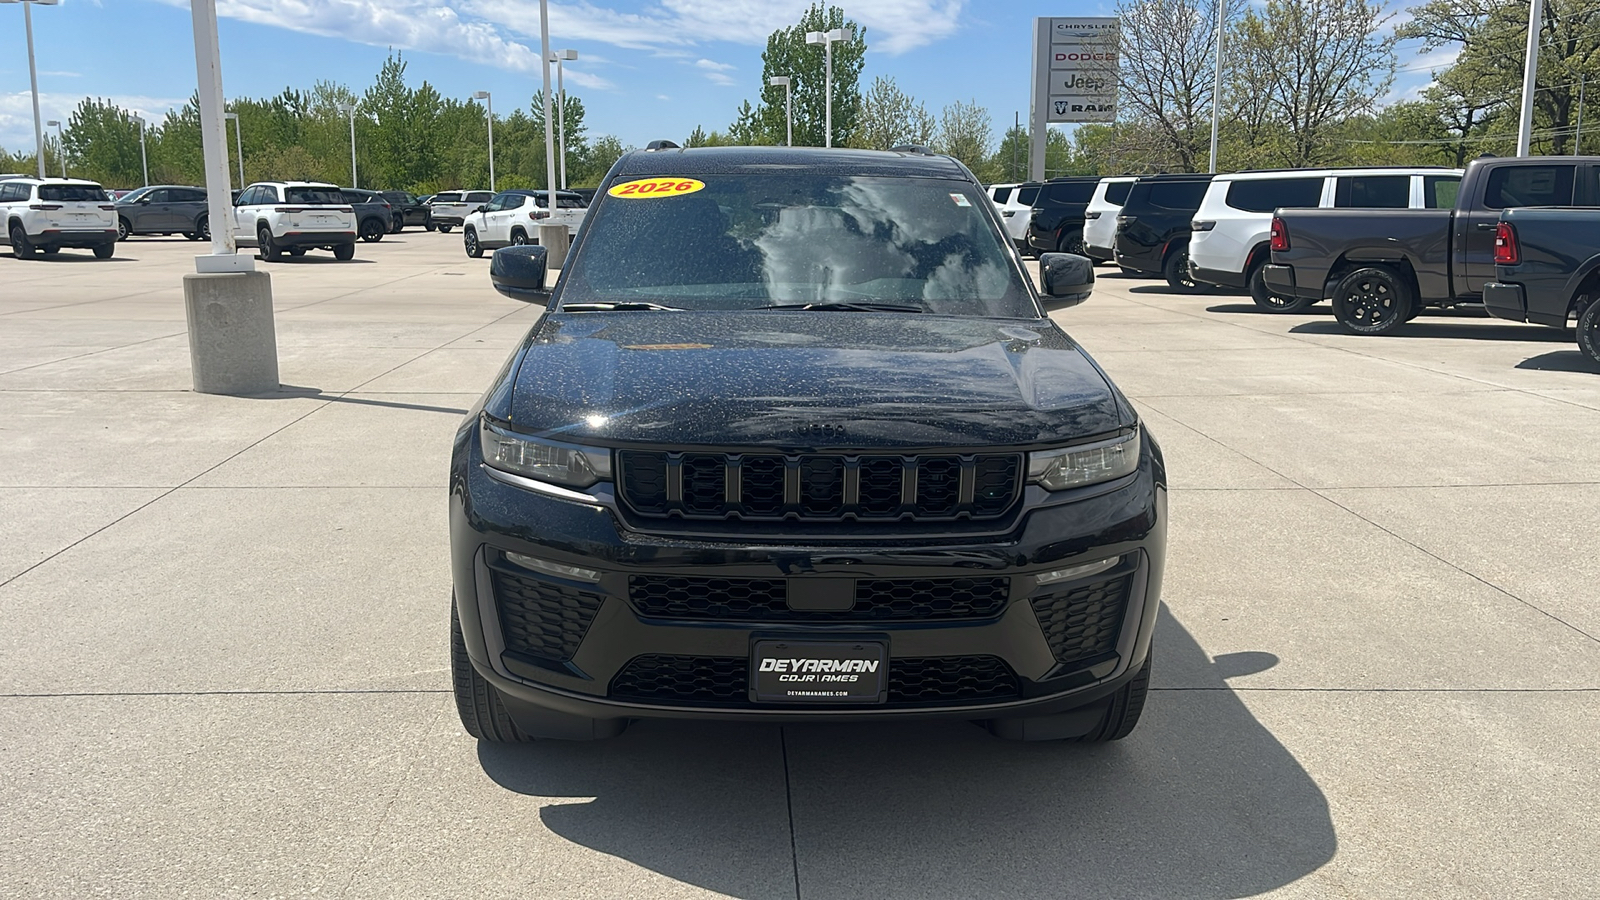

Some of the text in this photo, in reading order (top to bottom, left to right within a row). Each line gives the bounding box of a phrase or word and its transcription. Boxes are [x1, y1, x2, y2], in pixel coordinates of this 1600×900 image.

[1055, 53, 1116, 61] DODGE
[1064, 74, 1105, 91] Jeep
[1071, 104, 1114, 112] RAM
[618, 181, 694, 195] 2026
[759, 658, 879, 673] DEYARMAN
[779, 674, 859, 682] CDJR AMES
